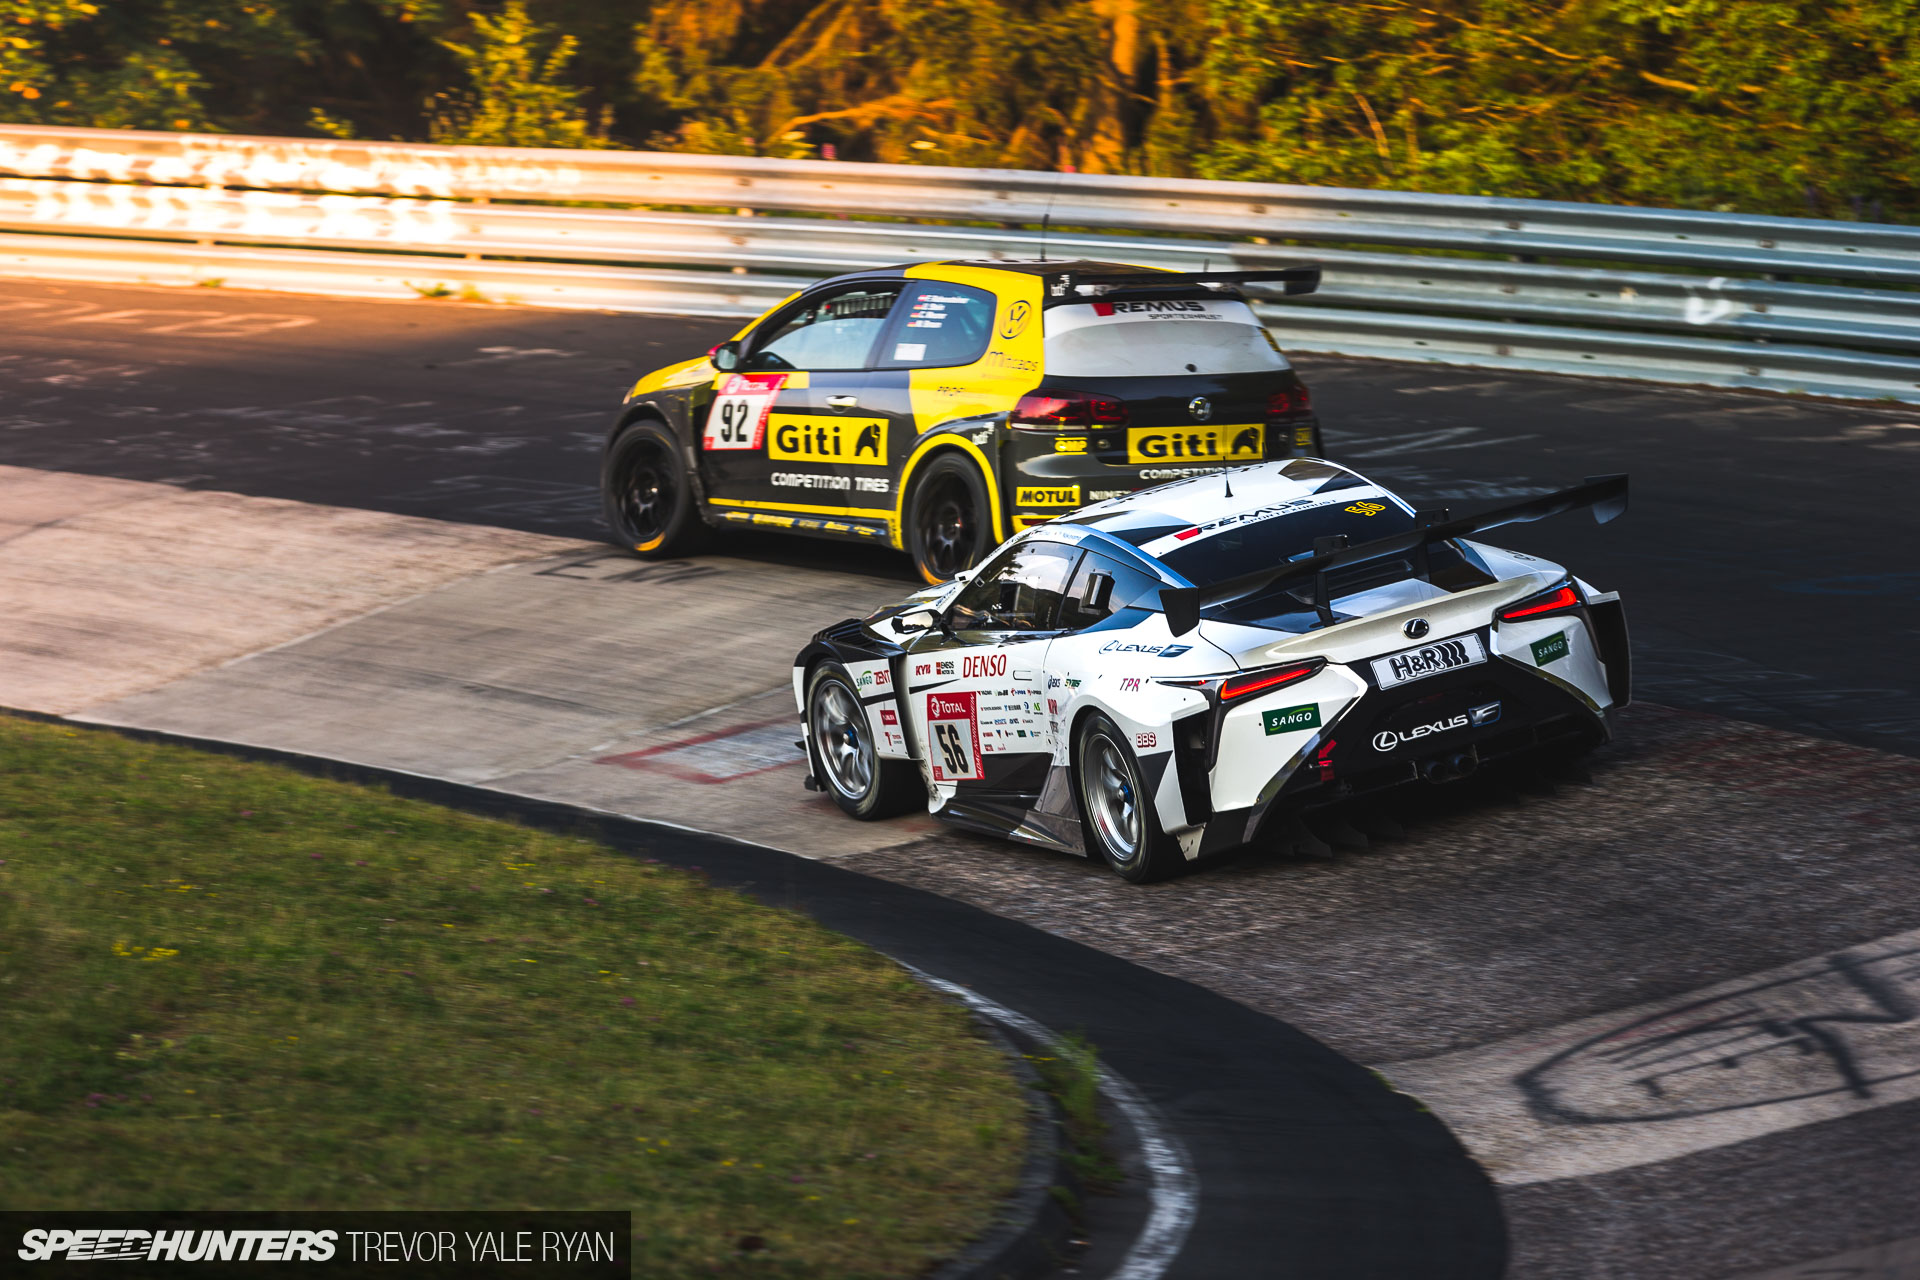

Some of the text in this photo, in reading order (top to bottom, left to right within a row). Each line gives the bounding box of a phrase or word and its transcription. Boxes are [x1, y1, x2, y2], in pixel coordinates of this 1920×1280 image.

[1113, 301, 1205, 314] REMUS
[721, 400, 748, 442] 92
[776, 425, 842, 456] Giti
[1137, 432, 1218, 458] Giti
[771, 472, 890, 493] COMPETITION TIRES
[1020, 490, 1076, 503] MOTUL
[1197, 500, 1314, 534] REMUS
[1344, 501, 1387, 517] 56
[1537, 641, 1565, 658] SANGO
[963, 654, 1007, 678] DENSO
[856, 675, 873, 687] SANGO
[874, 670, 890, 686] ZENT
[1119, 678, 1141, 692] TPR
[940, 701, 966, 714] TOTAL
[1272, 712, 1312, 727] SANGO
[1399, 714, 1469, 742] LEXUS
[1136, 732, 1156, 748] BBS
[934, 724, 969, 774] 56
